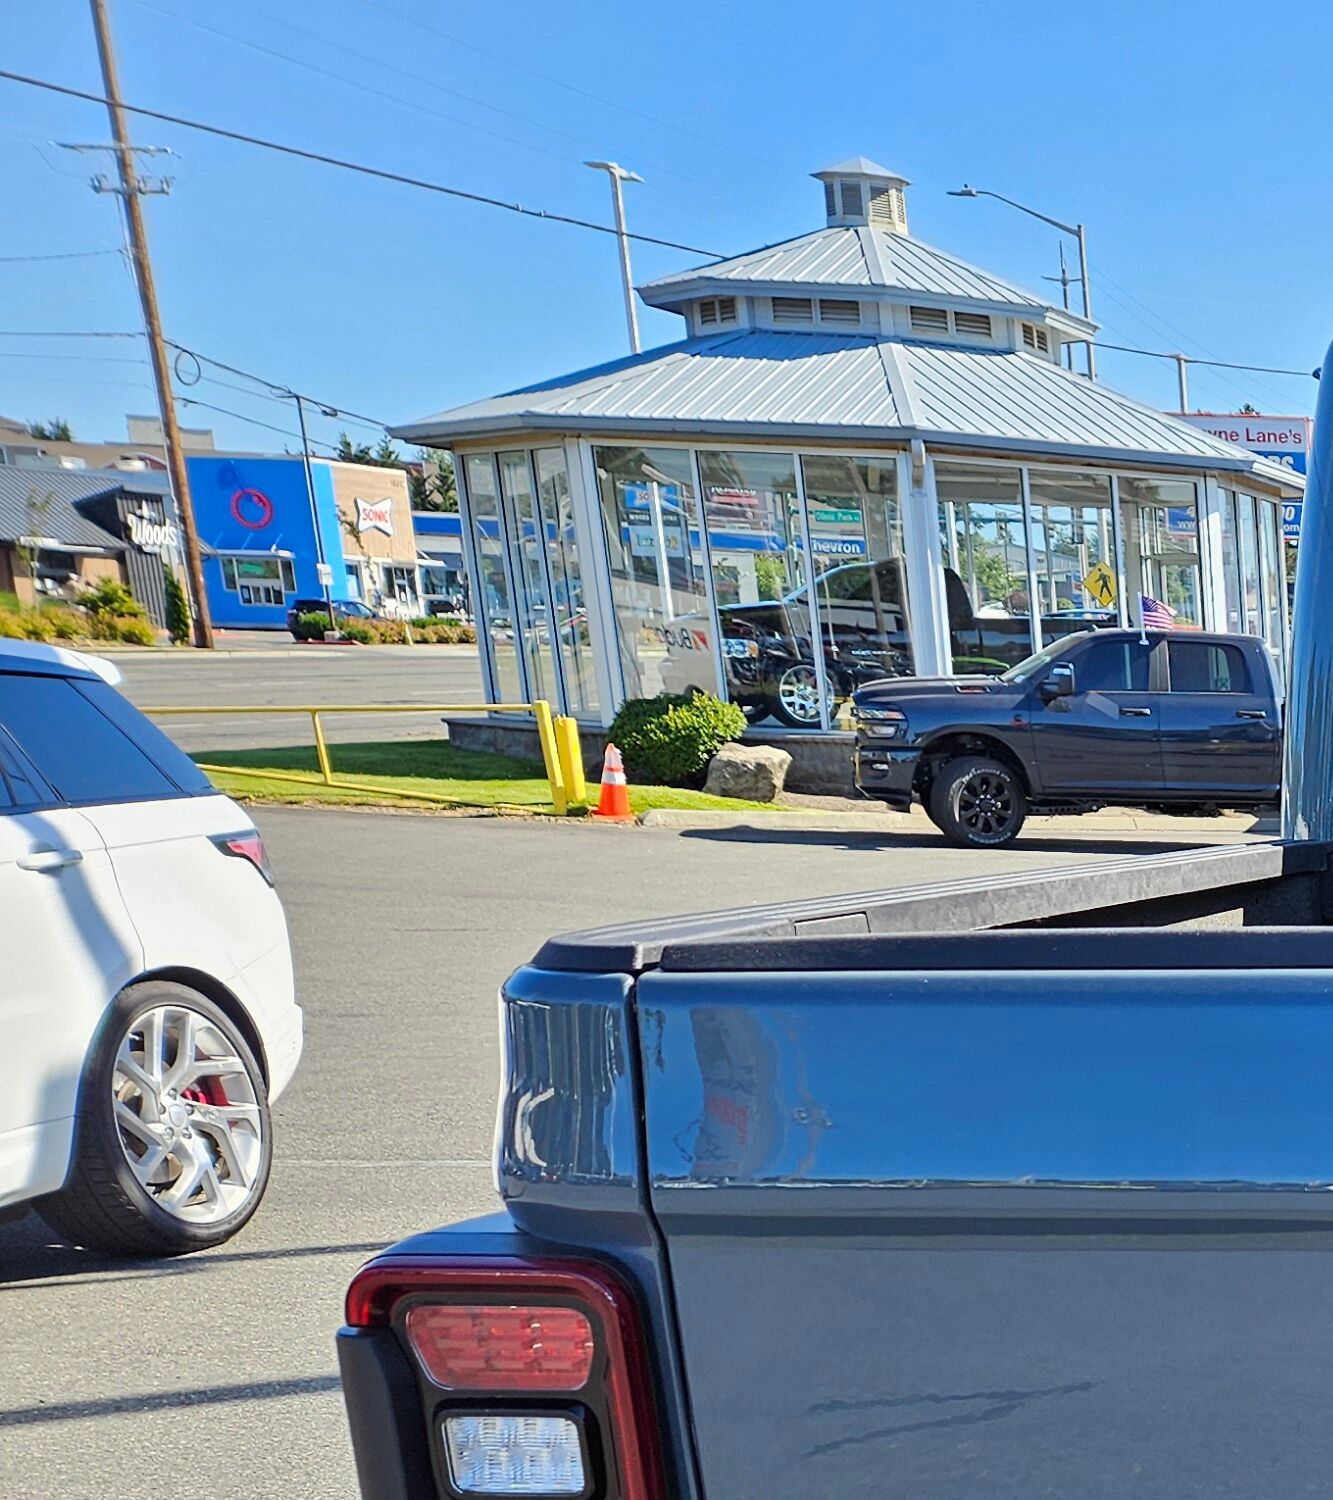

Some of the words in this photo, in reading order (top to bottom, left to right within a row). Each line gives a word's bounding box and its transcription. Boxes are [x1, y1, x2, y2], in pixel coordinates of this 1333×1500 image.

[1246, 427, 1302, 444] Lane's
[362, 507, 388, 523] SONIC
[127, 513, 179, 547] Woods
[812, 539, 861, 554] hevron
